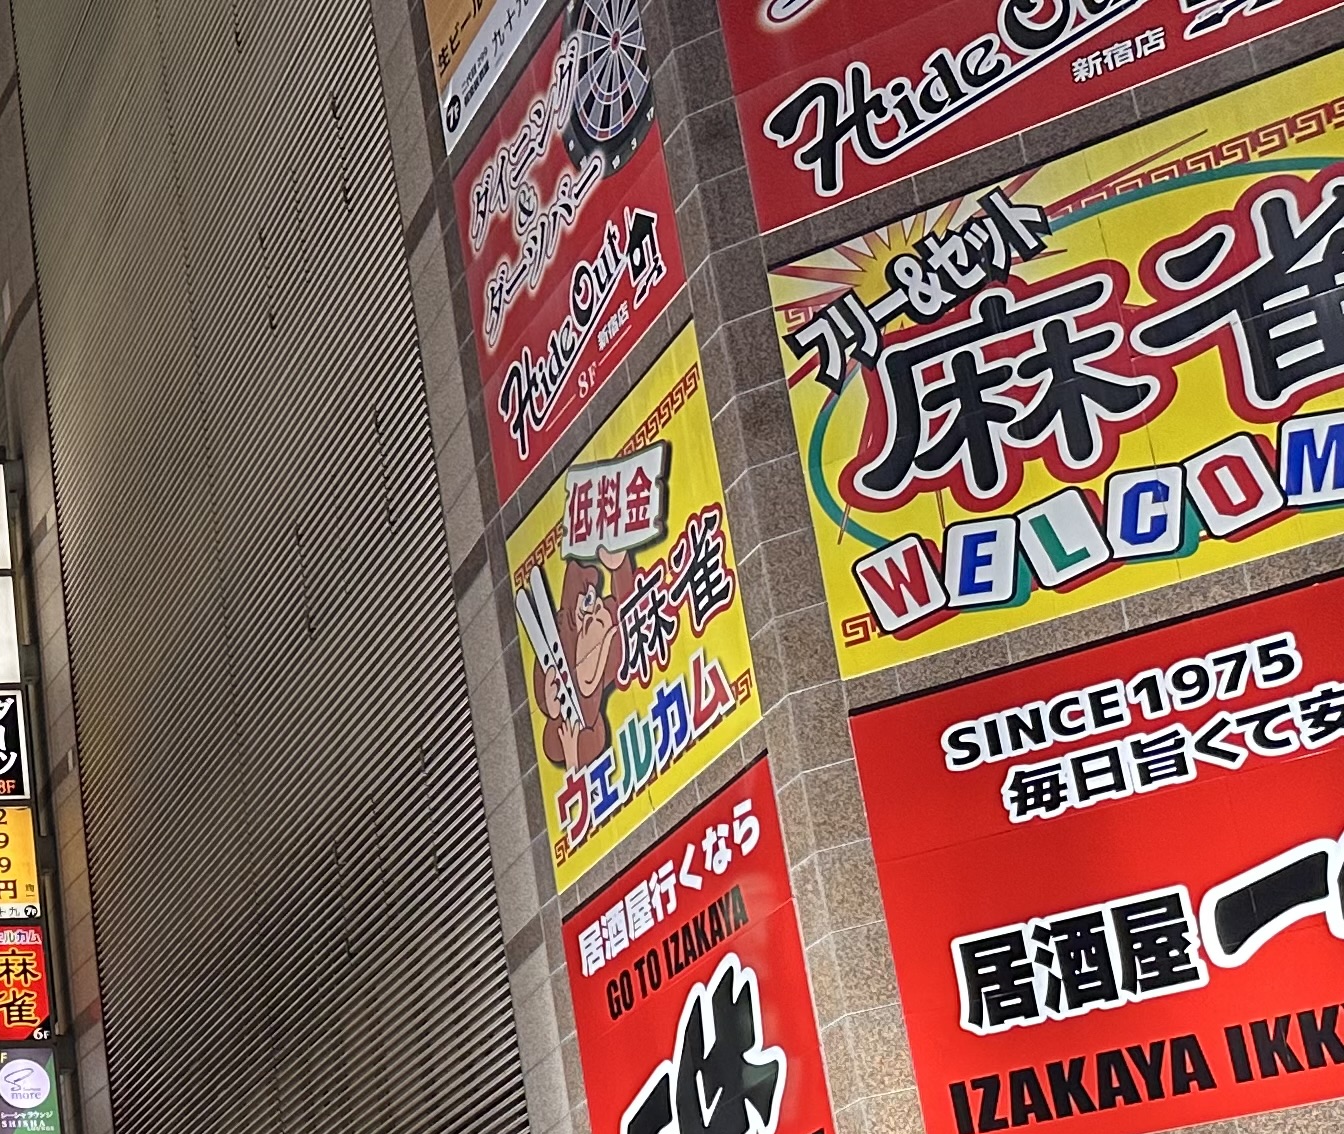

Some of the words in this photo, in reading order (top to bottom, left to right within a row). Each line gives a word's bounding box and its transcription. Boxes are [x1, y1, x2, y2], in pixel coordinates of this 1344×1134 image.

[1071, 28, 1167, 85] 新宿店
[597, 300, 630, 350] 新宿店
[576, 361, 599, 400] 8F
[568, 467, 652, 545] 低料金
[618, 508, 733, 686] 麻雀
[576, 798, 762, 979] 居酒屋行くなら
[606, 976, 634, 1022] GO
[635, 957, 664, 997] TO
[665, 884, 749, 983] IZAKAYA
[33, 1027, 50, 1040] 6F
[1226, 1006, 1344, 1084] IKK
